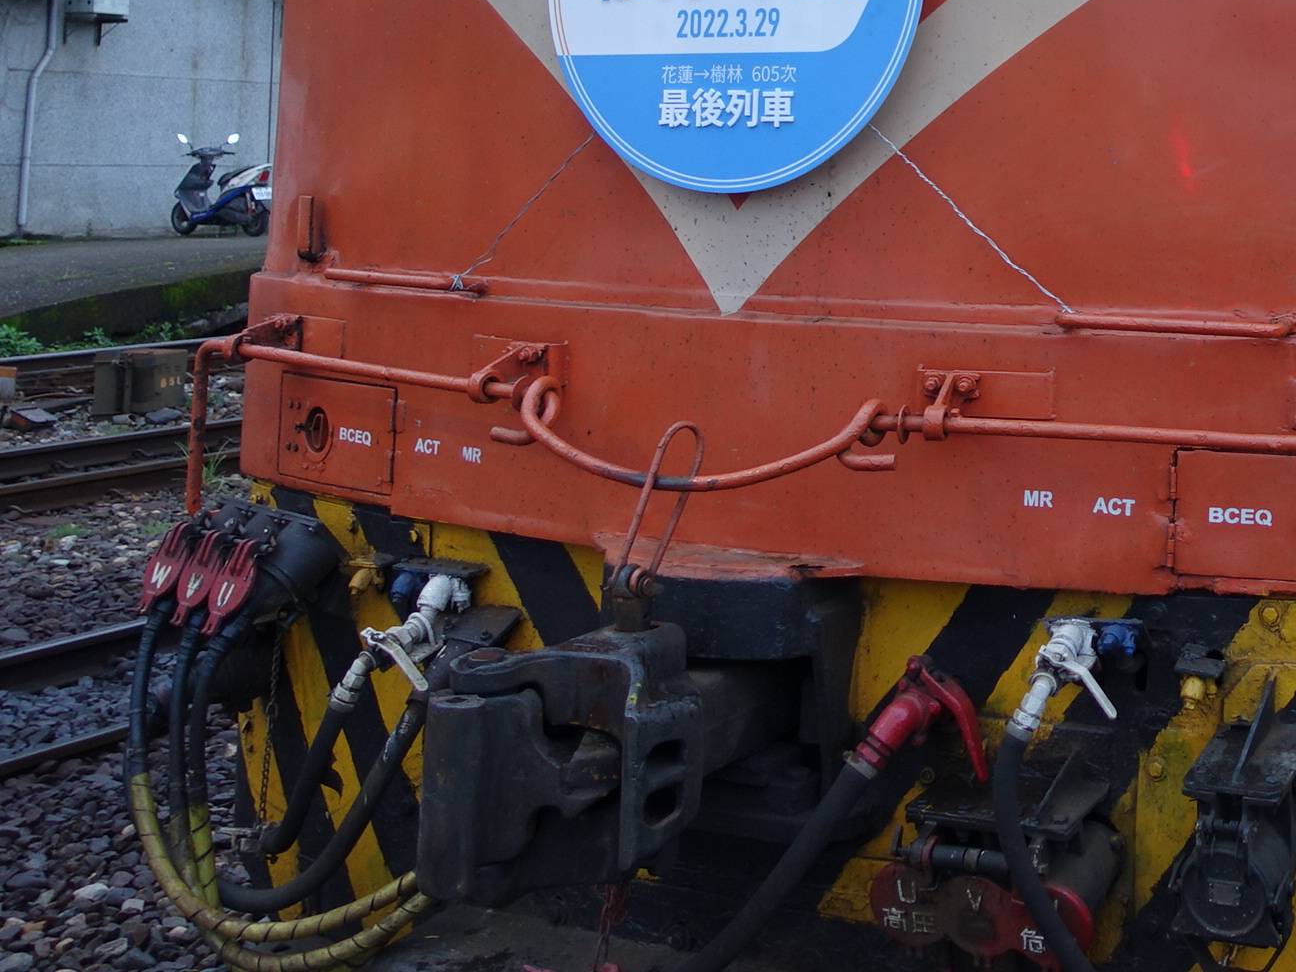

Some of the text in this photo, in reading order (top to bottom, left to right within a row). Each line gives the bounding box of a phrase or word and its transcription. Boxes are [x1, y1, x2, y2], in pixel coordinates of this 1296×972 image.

[676, 7, 781, 39] 2022.3.29
[752, 62, 798, 84] 605次
[658, 87, 796, 129] 最後列車
[338, 426, 372, 448] BCEQ
[414, 437, 482, 464] ACT MR
[1023, 489, 1136, 518] MR ACT
[1207, 506, 1274, 529] BCEQ
[151, 561, 172, 589] W
[217, 580, 236, 608] U
[896, 879, 918, 904] U
